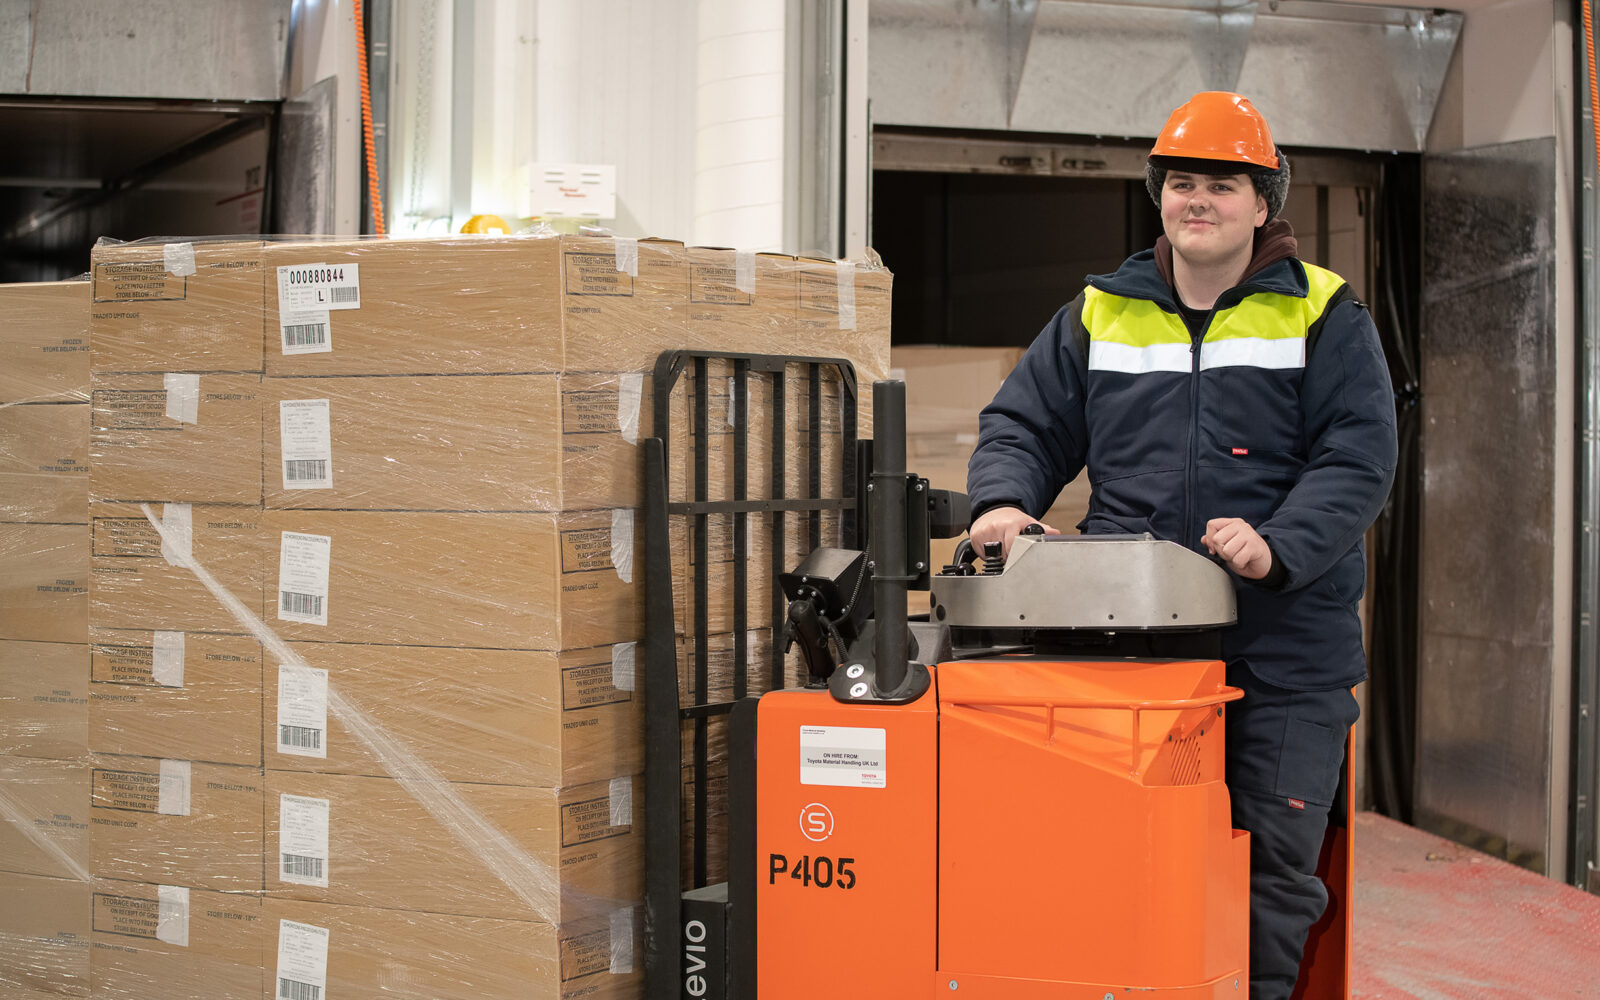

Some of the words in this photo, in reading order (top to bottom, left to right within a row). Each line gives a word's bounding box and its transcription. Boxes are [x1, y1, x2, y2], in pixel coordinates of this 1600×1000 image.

[290, 268, 344, 284] 000880844
[318, 290, 325, 302] L
[570, 670, 590, 678] STORAGE
[769, 853, 856, 889] P405
[103, 897, 129, 906] STORAGE
[224, 912, 242, 920] BELOW
[685, 920, 707, 1000] evio
